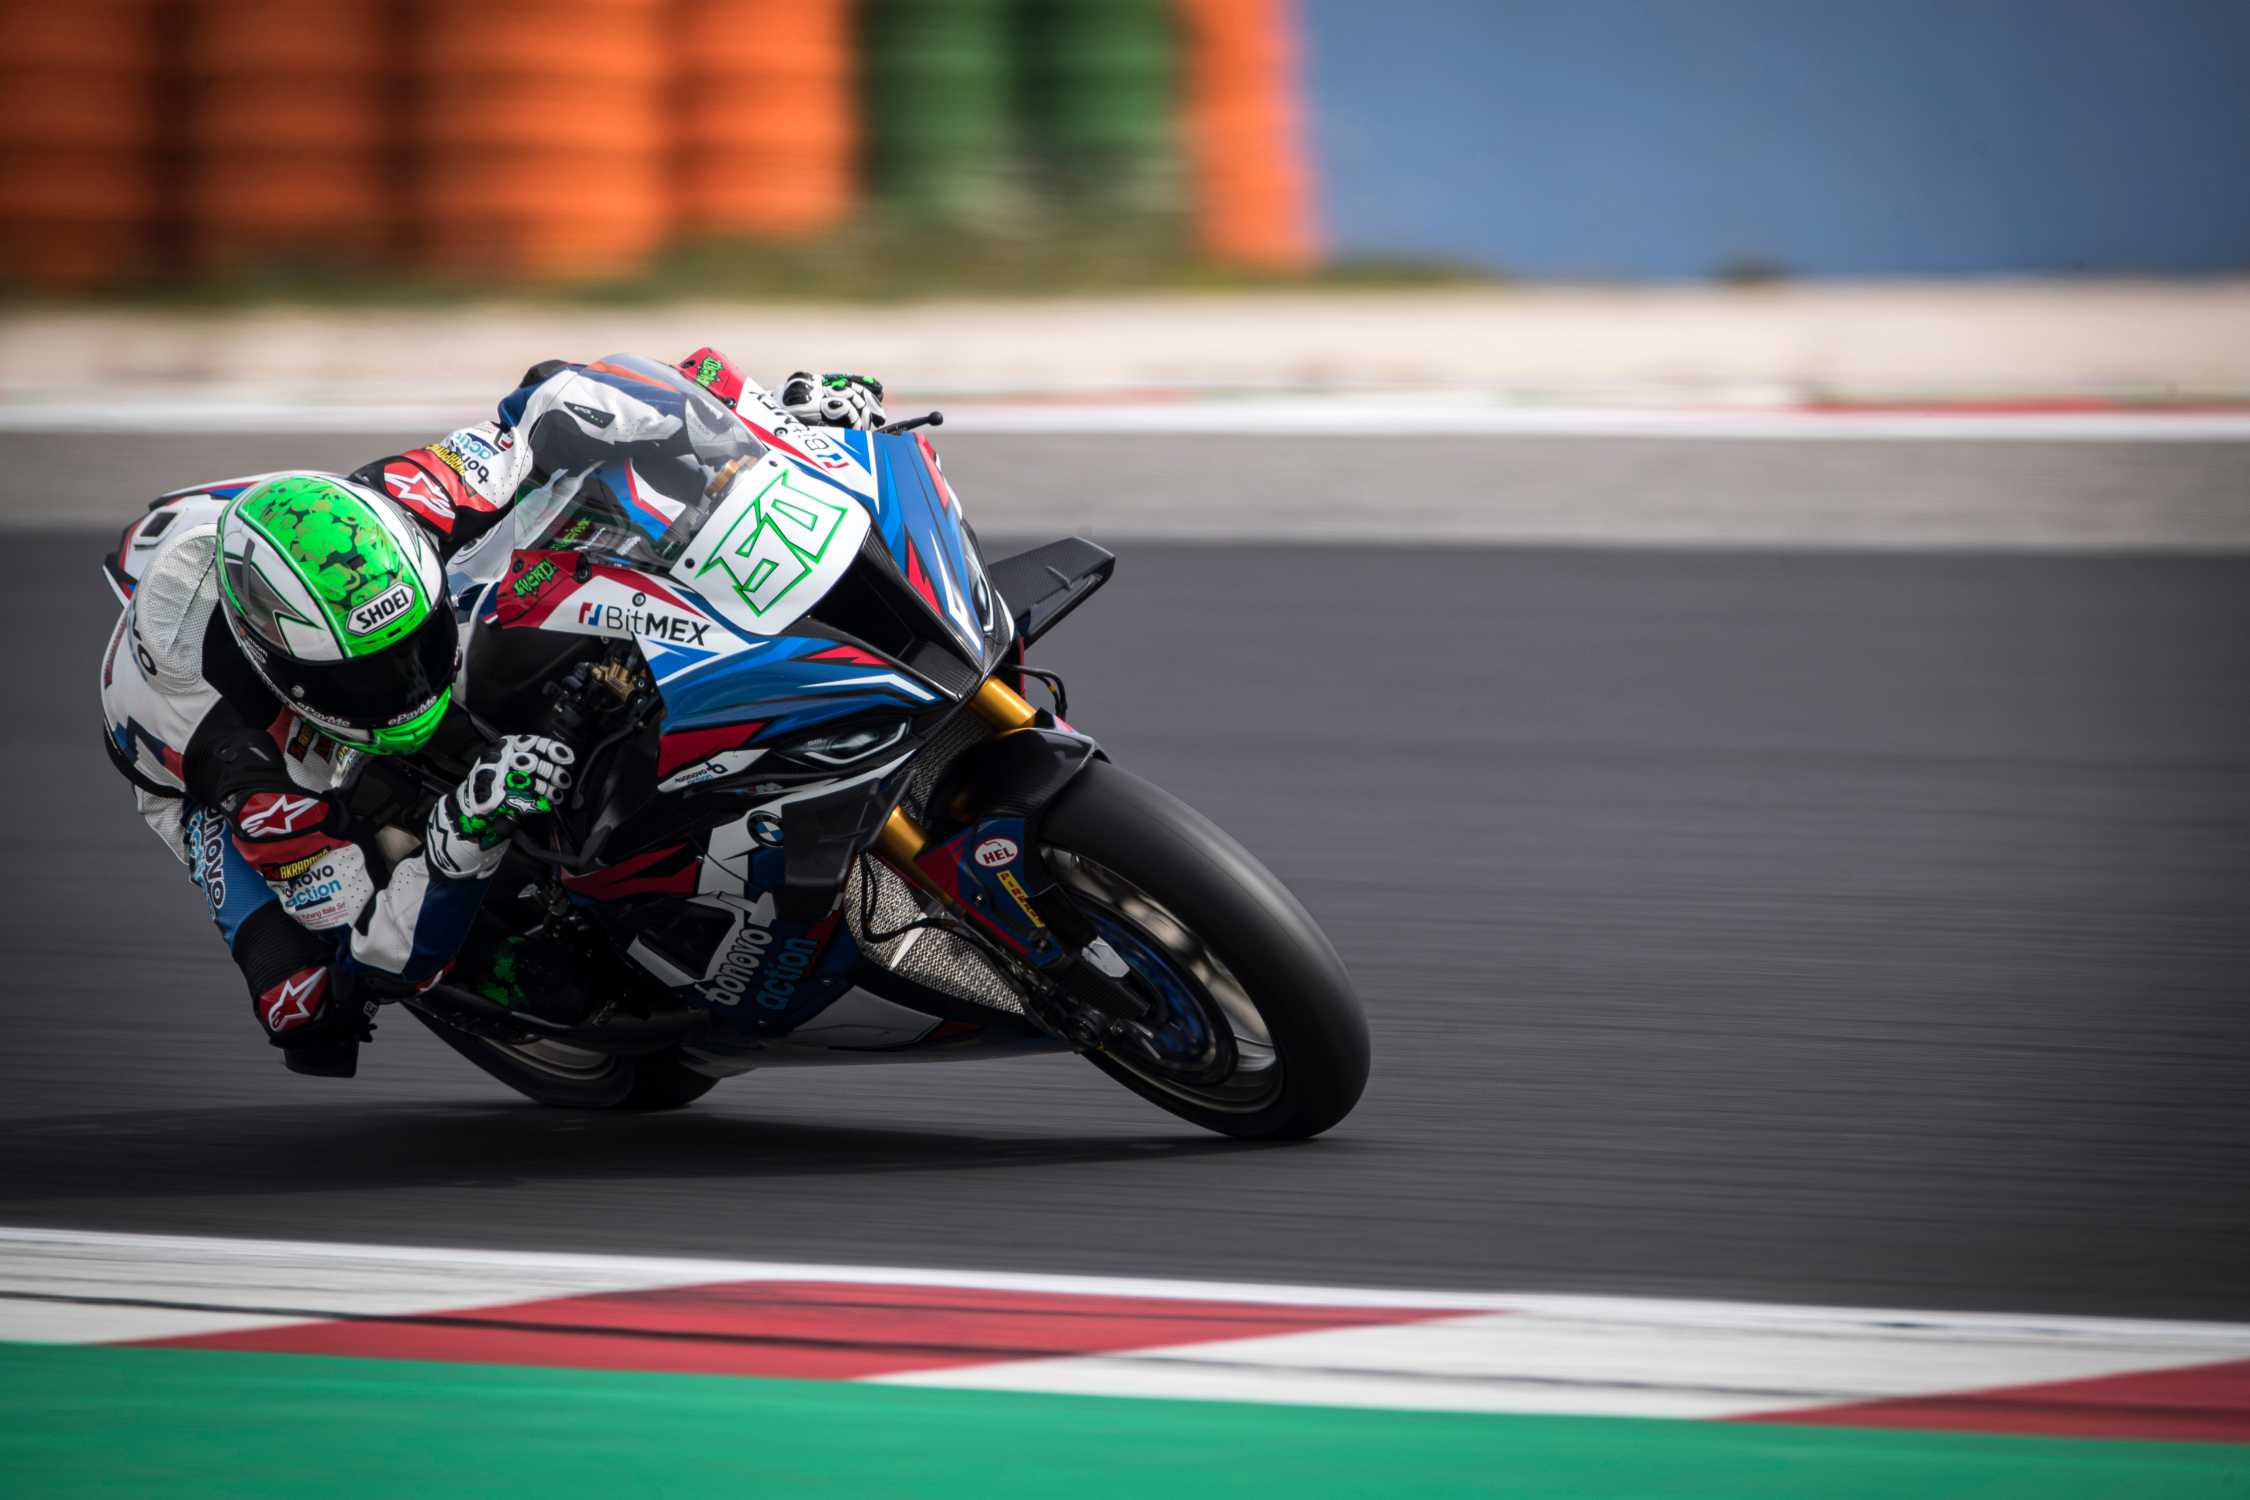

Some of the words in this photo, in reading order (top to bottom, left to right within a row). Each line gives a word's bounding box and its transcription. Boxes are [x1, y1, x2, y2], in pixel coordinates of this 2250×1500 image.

[356, 587, 409, 630] SHOEI
[605, 605, 711, 647] BitMEX
[297, 701, 351, 728] ePayMe
[982, 847, 1015, 865] HEL
[285, 879, 342, 907] action
[694, 926, 773, 1007] bonovo
[755, 937, 817, 1010] action
